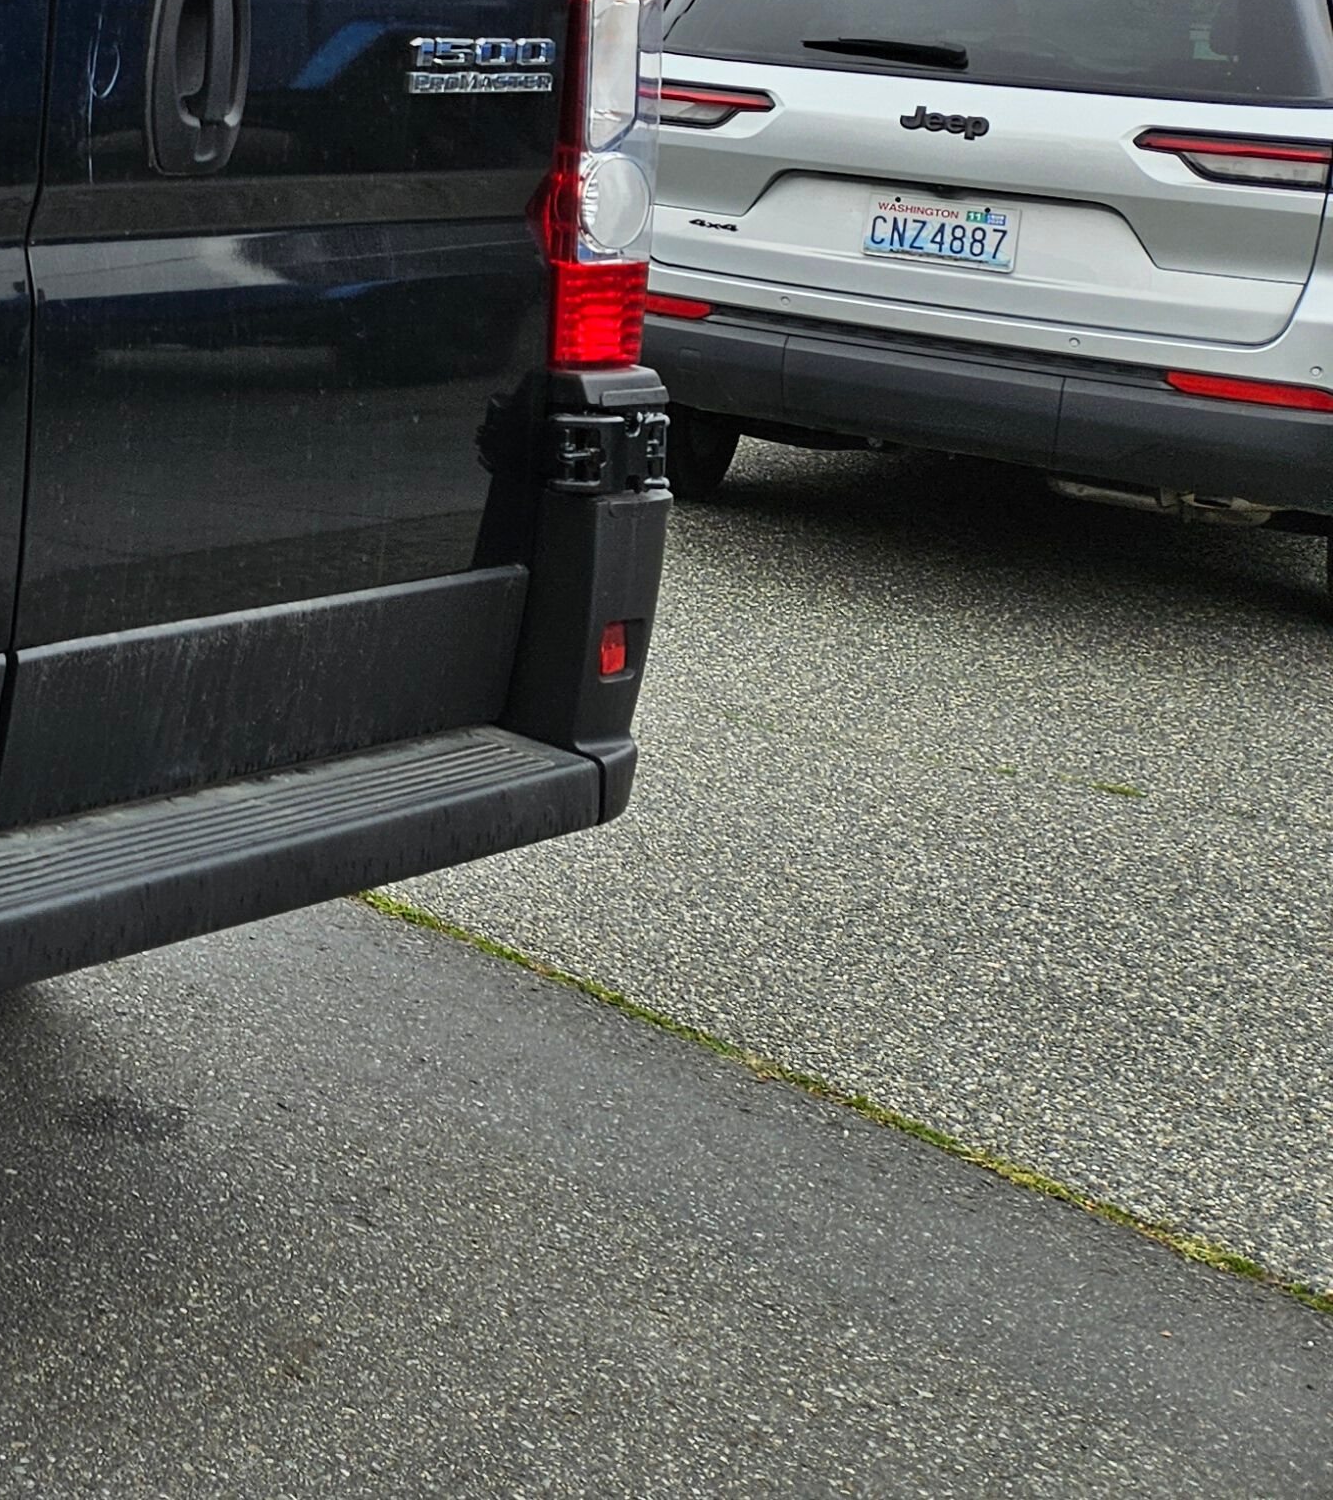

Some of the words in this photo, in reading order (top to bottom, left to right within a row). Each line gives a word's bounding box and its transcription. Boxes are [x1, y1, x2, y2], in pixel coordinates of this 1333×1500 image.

[409, 36, 556, 66] 1500
[899, 105, 990, 141] Jeep
[878, 202, 959, 219] WASHINGTON
[871, 215, 1008, 260] CNZ4887
